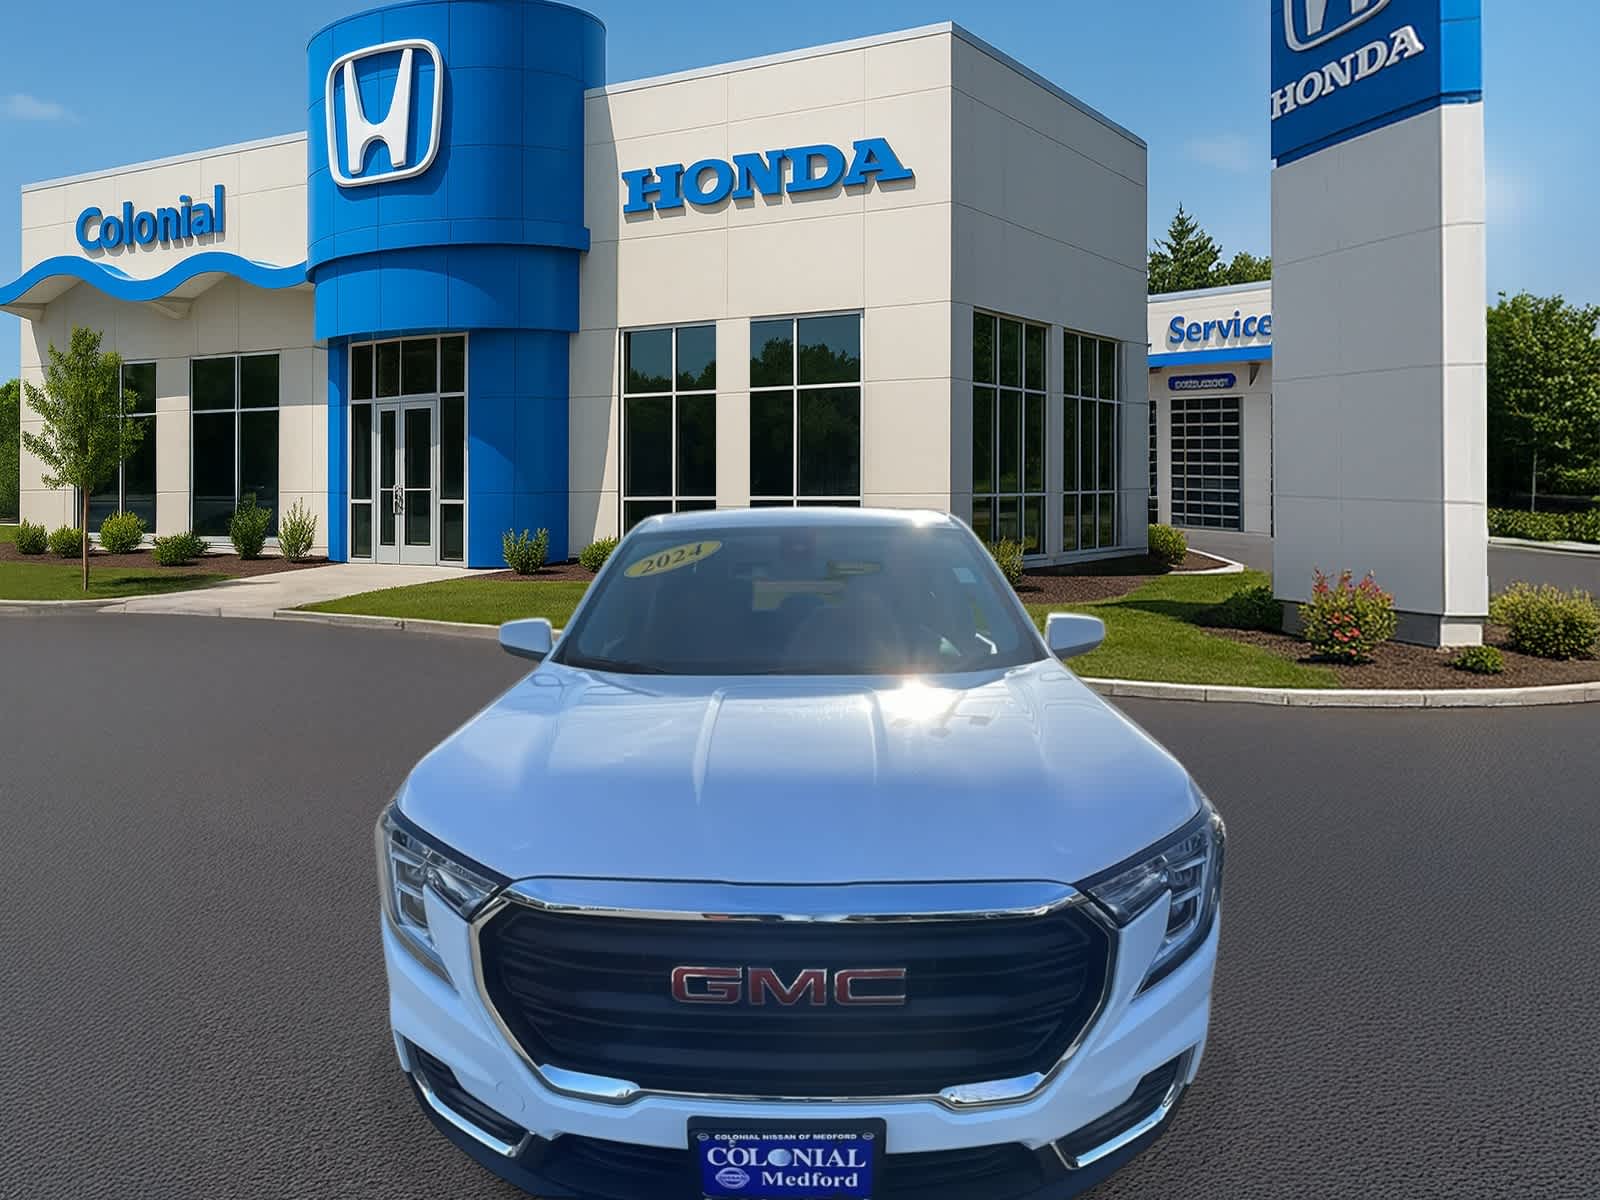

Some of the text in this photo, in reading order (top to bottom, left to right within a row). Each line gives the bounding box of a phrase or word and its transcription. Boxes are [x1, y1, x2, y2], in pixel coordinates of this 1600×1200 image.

[1271, 25, 1424, 121] HONDA
[622, 136, 914, 214] HONDA
[75, 184, 225, 250] Colonial
[1169, 310, 1272, 344] Service
[640, 542, 704, 574] 2024
[670, 965, 908, 1007] GMC
[714, 1133, 857, 1141] COLONIAL NISSAN OF MEDFORD
[706, 1146, 866, 1168] COLONIAL
[761, 1171, 859, 1188] Medford
